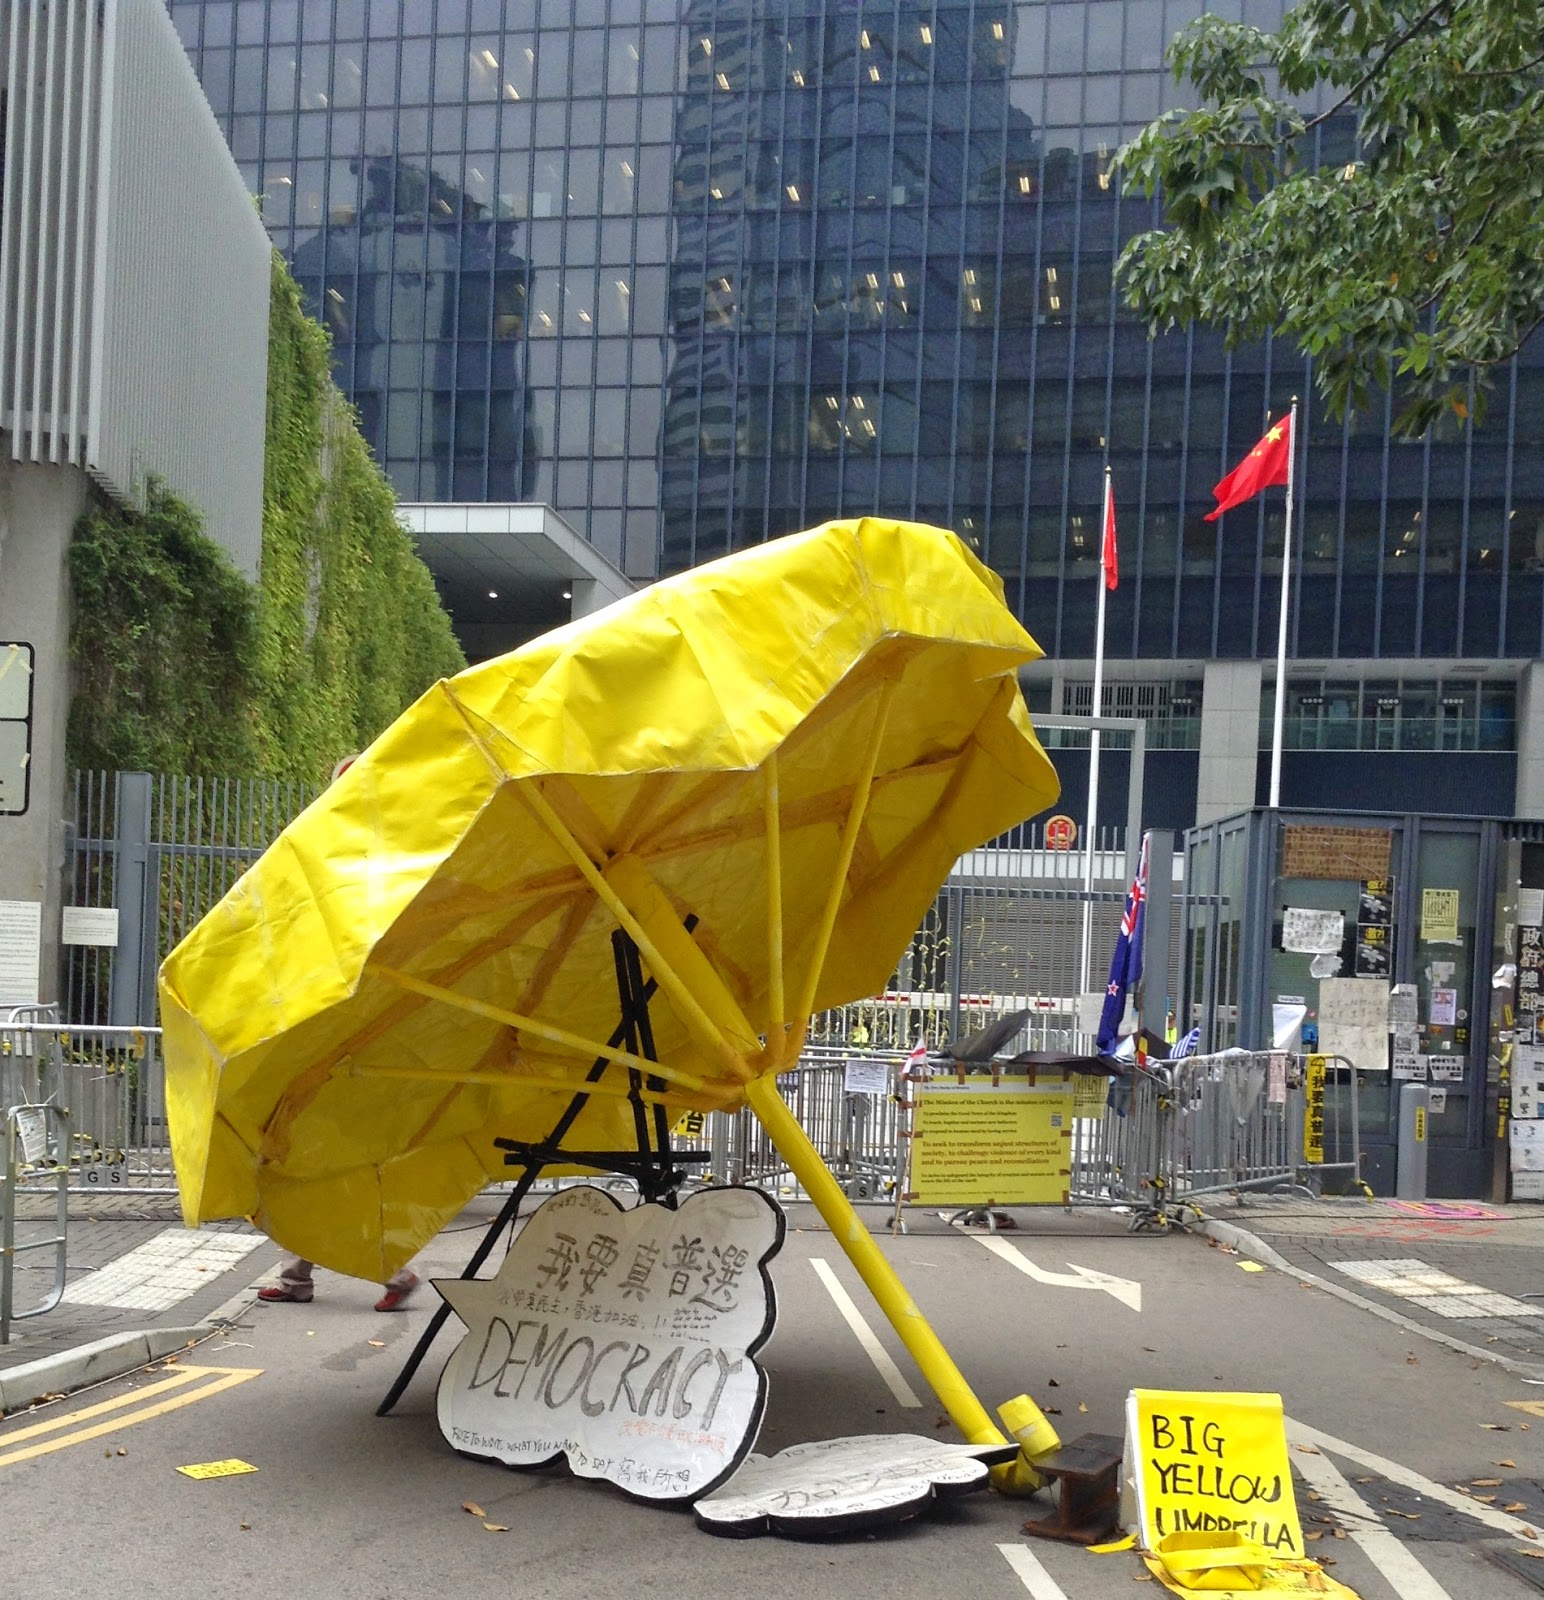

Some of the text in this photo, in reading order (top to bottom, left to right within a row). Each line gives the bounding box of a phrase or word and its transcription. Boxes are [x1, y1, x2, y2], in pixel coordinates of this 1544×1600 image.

[957, 1149, 989, 1157] challenge
[1046, 1148, 1062, 1156] kind
[992, 1140, 1014, 1148] unjust
[87, 1171, 121, 1183] G S
[859, 1186, 868, 1198] S
[536, 1231, 749, 1314] 我要真普選
[467, 1316, 743, 1431] DEMOCRACY
[1151, 1414, 1225, 1459] BIG
[1151, 1458, 1282, 1504] YELLOW
